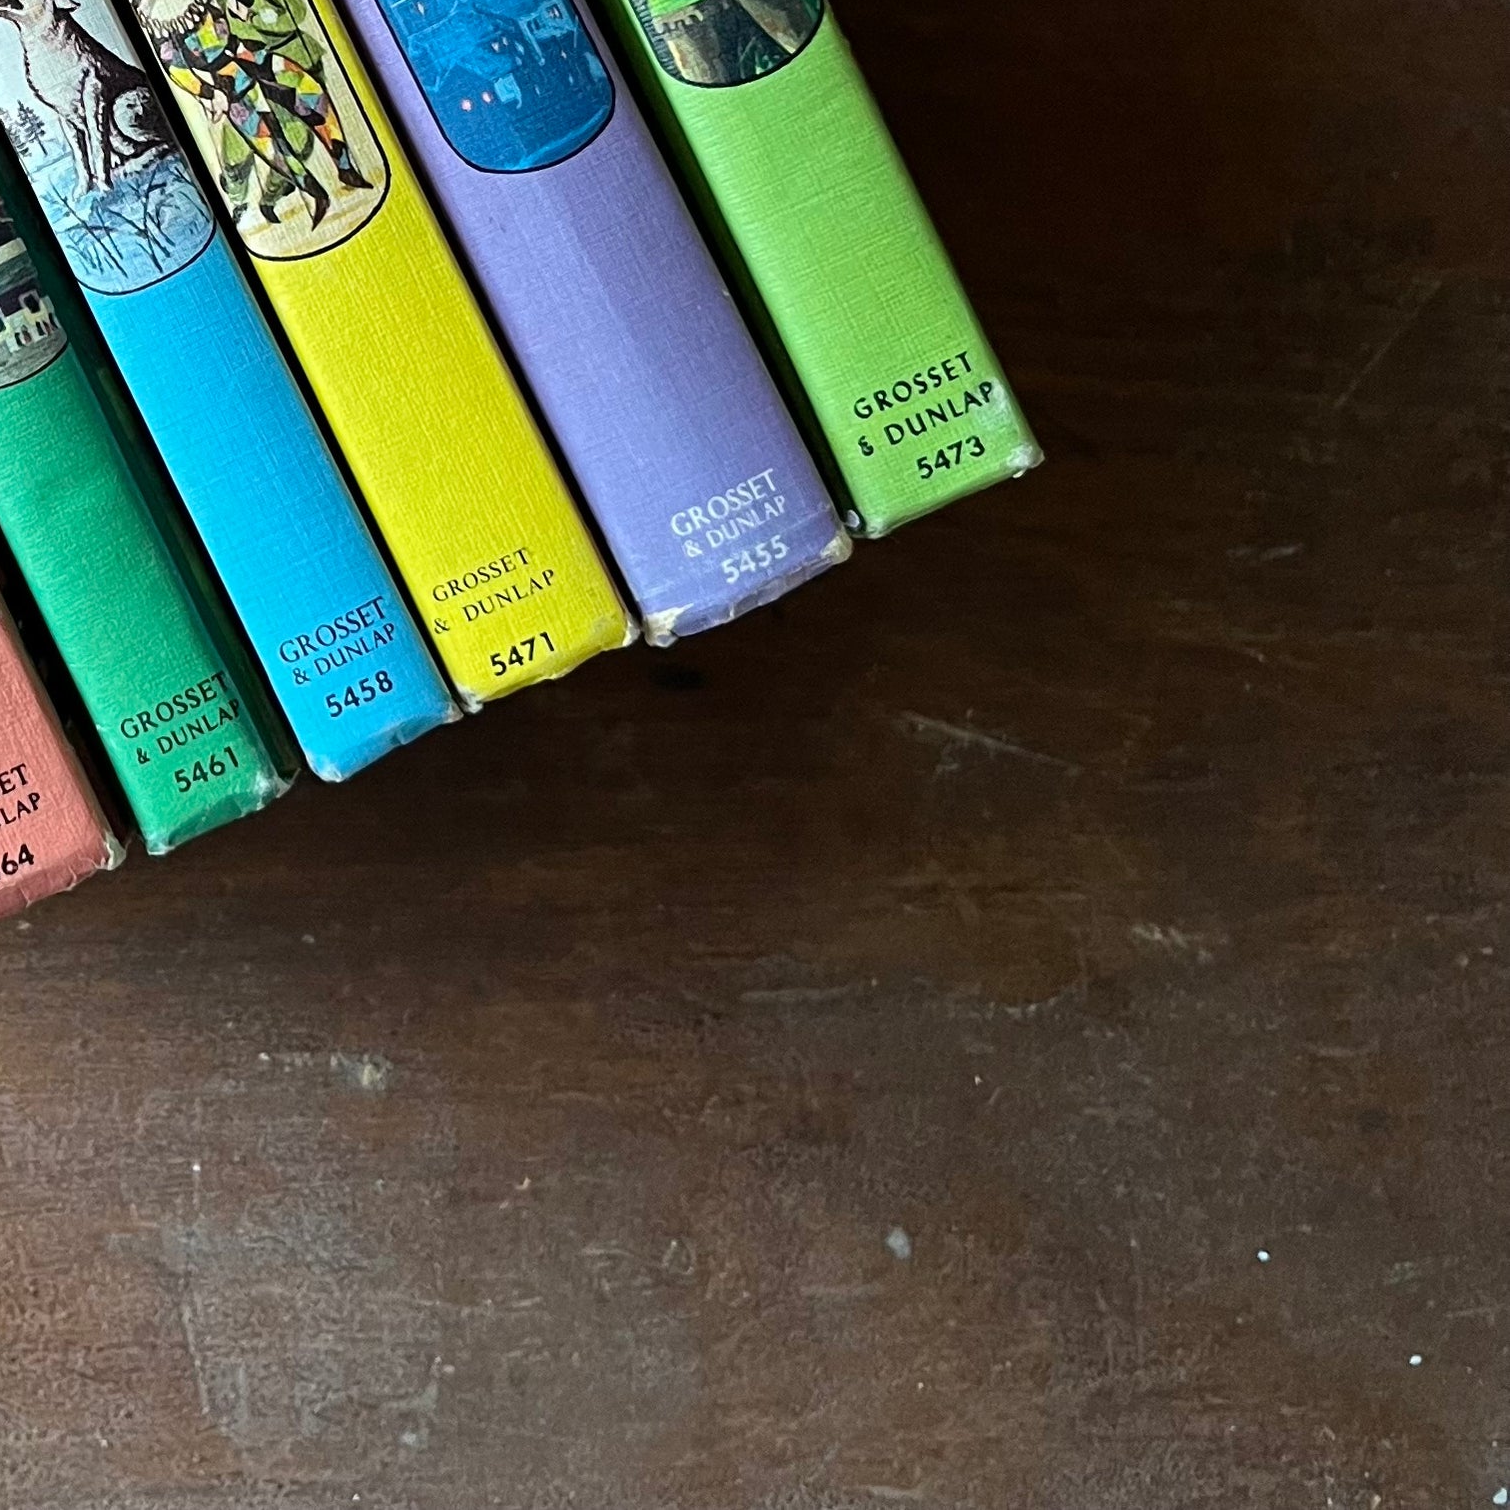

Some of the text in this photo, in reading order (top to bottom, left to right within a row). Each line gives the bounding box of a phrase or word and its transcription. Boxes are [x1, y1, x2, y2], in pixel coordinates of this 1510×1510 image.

[853, 350, 973, 420] GROSSET
[883, 381, 994, 446] DUNLAP
[916, 434, 986, 480] 5473
[670, 467, 779, 538] GROSSET
[683, 494, 787, 558] & DUNLAP
[431, 546, 531, 603] GROSSET
[721, 535, 789, 585] 5455
[279, 595, 389, 664] GROSSET
[433, 568, 555, 635] & DUNLAP
[293, 622, 395, 685] & DUNLAP
[490, 631, 555, 677] 5471
[120, 670, 229, 739] GROSSET
[326, 670, 393, 718] 5458
[136, 698, 240, 765] & DUNLAP
[174, 746, 239, 792] 5461
